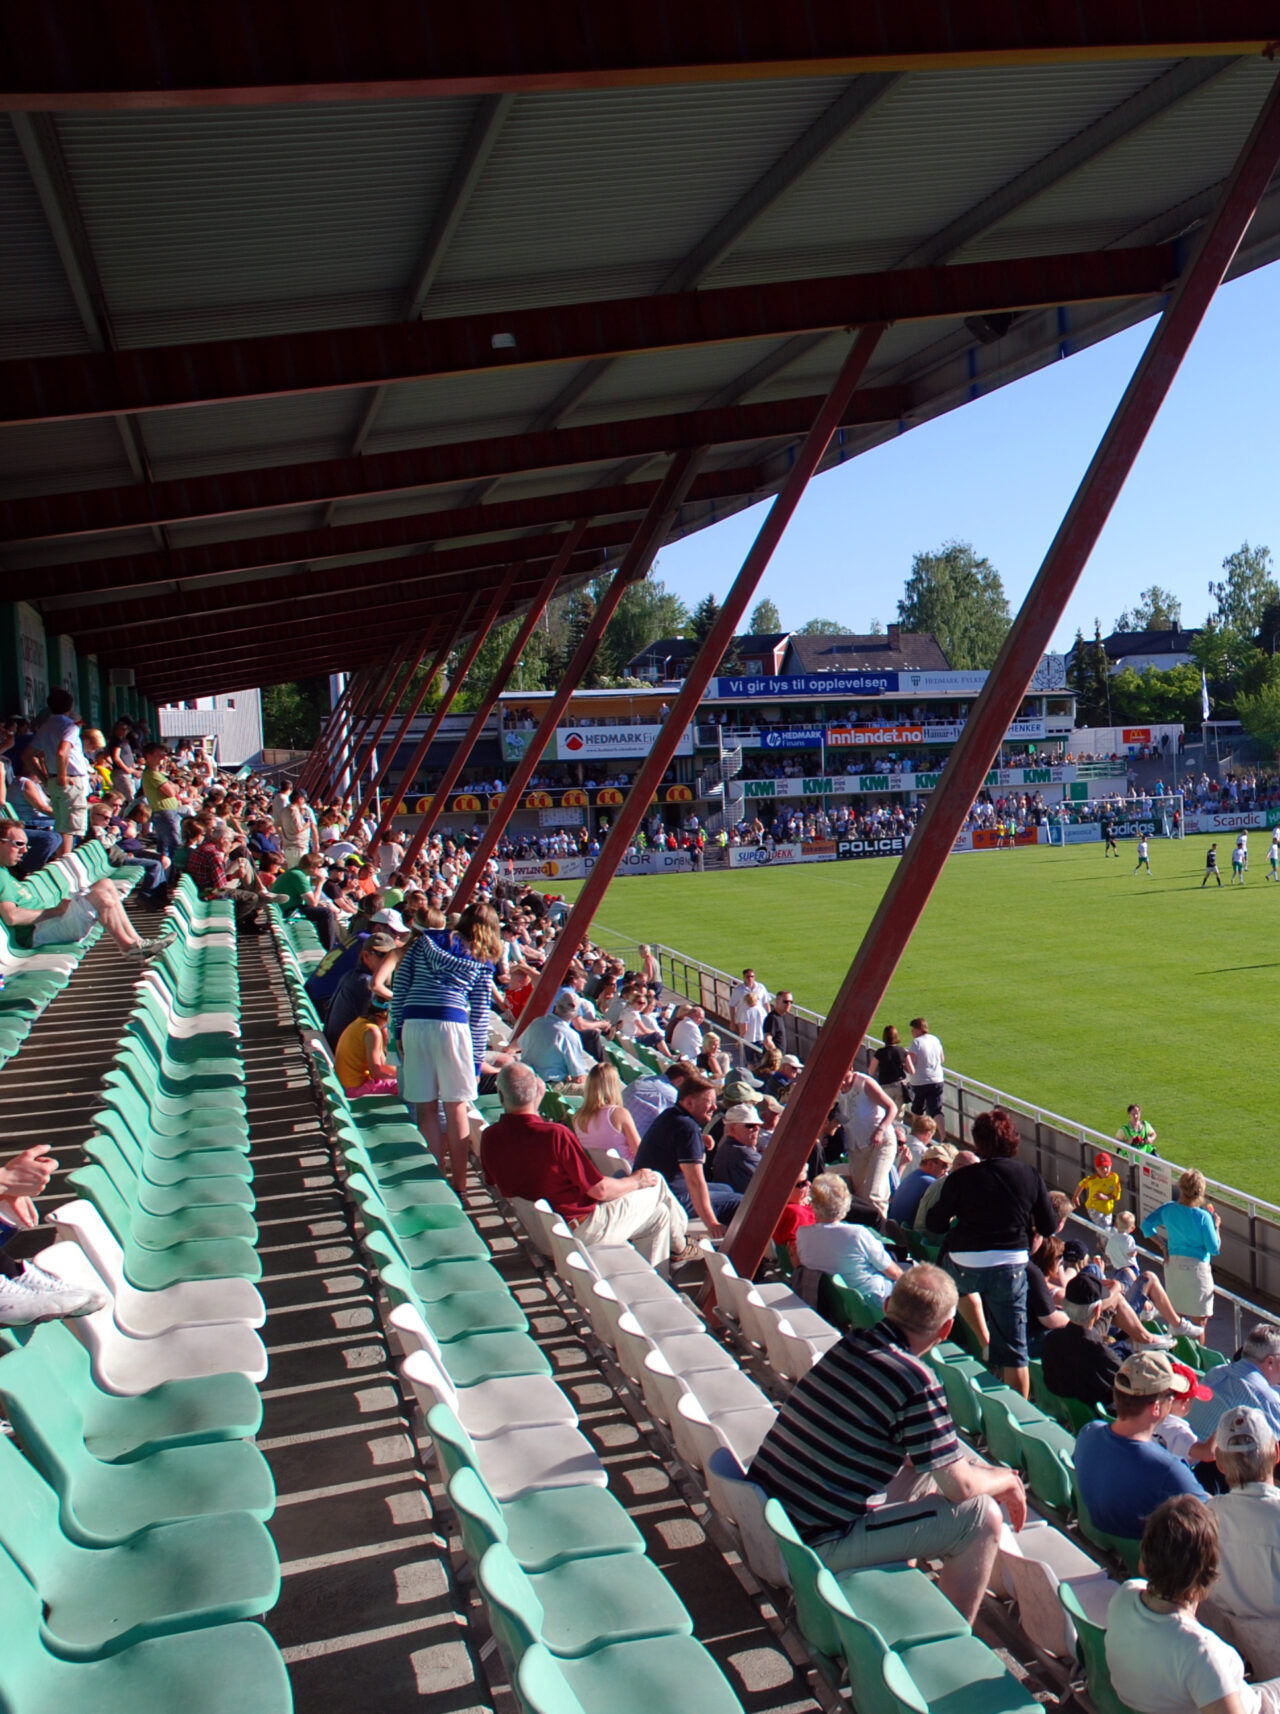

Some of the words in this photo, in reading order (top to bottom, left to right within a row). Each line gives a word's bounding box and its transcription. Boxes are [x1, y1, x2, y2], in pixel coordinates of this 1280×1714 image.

[729, 680, 743, 692] Vi
[747, 680, 765, 693] gir
[769, 680, 788, 692] lys
[792, 679, 805, 690] til
[809, 677, 888, 692] opplevelsen
[782, 731, 822, 739] HEDMARK
[828, 728, 921, 745] innlandet.no
[859, 775, 889, 791] KIWI
[915, 773, 942, 788] KIW
[1023, 768, 1051, 783] KIWI
[744, 781, 775, 797] KIWI
[802, 778, 833, 794] KIWI
[1213, 813, 1261, 827] Scandic
[1111, 821, 1155, 835] adidas
[839, 839, 903, 853] POLICE
[738, 851, 765, 861] SUPER
